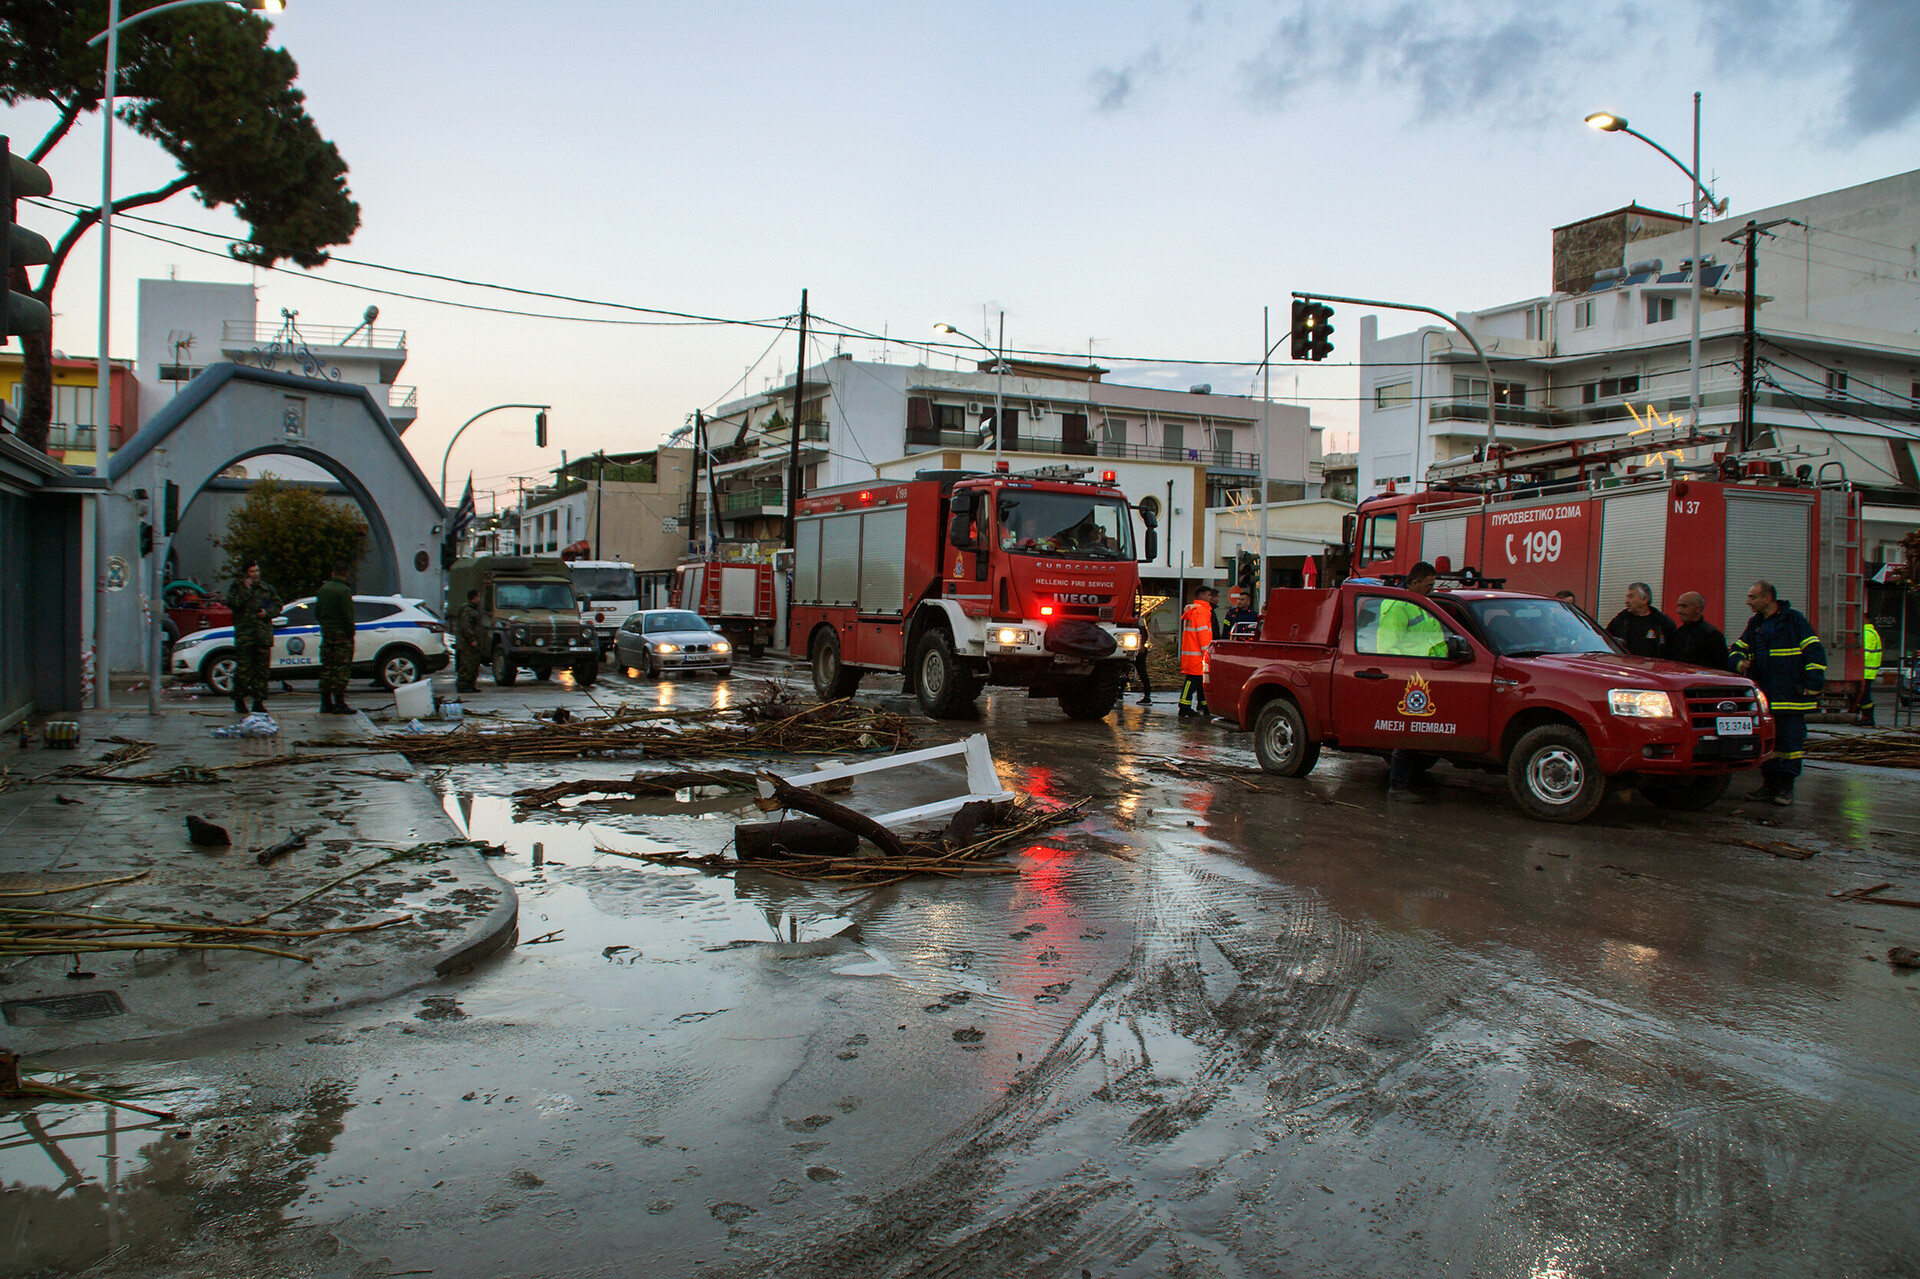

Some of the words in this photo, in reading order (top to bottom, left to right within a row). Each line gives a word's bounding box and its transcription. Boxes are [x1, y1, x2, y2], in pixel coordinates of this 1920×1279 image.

[1686, 500, 1700, 514] 37
[1491, 508, 1554, 526] ΠΥΡΟΣΒΕΣΤΙΚΟ
[1555, 505, 1582, 519] ΣΩΜΑ
[1522, 530, 1562, 563] 199
[1036, 562, 1115, 571] EUROCARGO
[1035, 578, 1069, 586] HELLENIC
[1053, 593, 1099, 605] IVECO
[279, 657, 312, 665] POLICE
[1374, 719, 1405, 732] ΑΜΕΣΗ
[1410, 721, 1456, 734] ΕΠΕΜΒΑΣΗ
[1732, 721, 1751, 731] 3744
